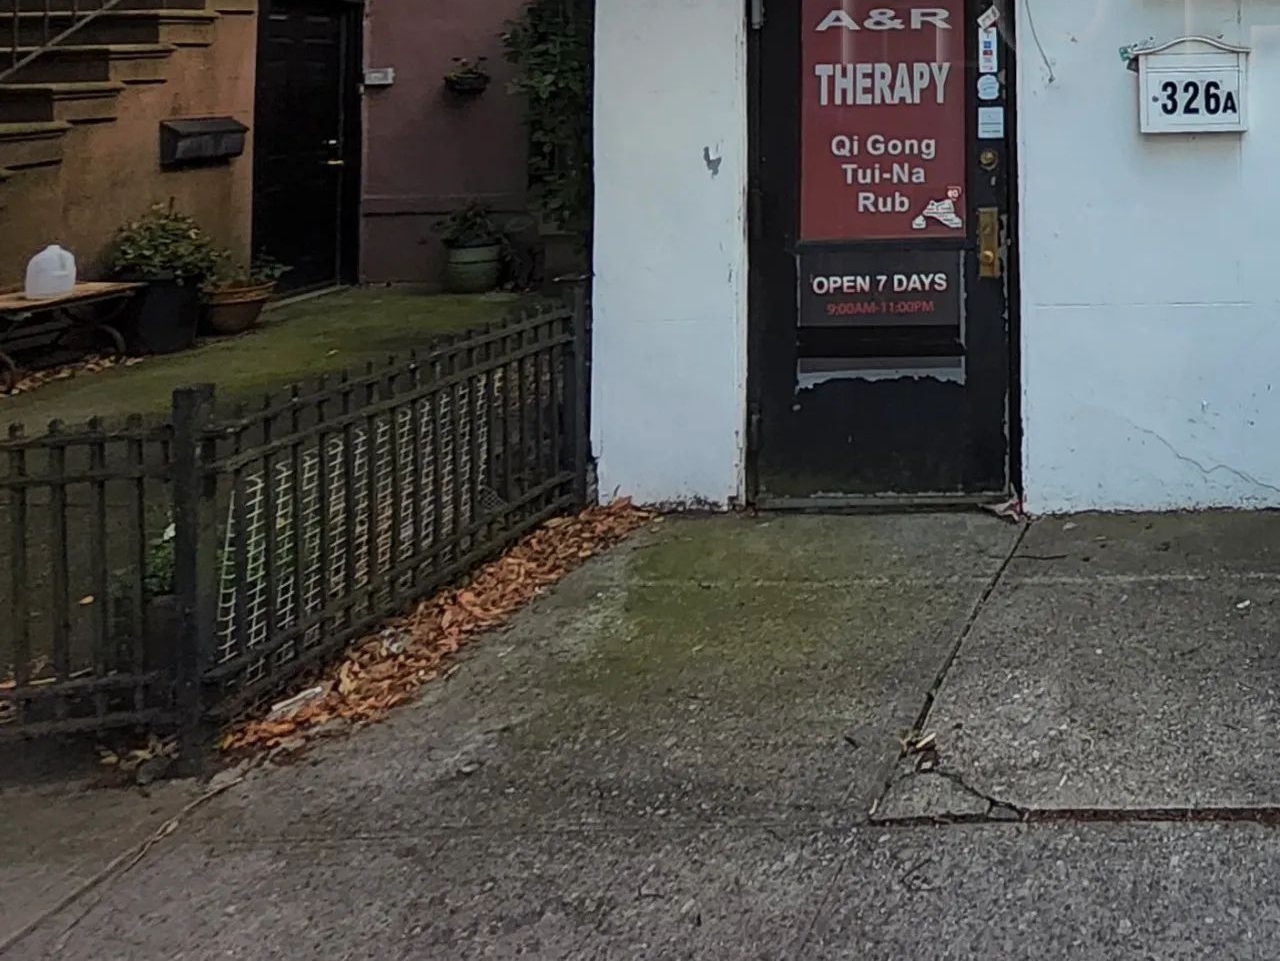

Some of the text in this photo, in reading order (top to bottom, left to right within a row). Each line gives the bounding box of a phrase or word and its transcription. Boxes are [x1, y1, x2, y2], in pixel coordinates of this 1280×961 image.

[815, 8, 953, 31] A&R
[815, 63, 950, 105] THERAPY
[1161, 81, 1237, 115] 326A
[831, 135, 936, 159] Qi Gong
[842, 164, 926, 184] Tui-Na
[858, 192, 910, 213] Rub
[812, 273, 947, 294] OPEN 7 DAYS
